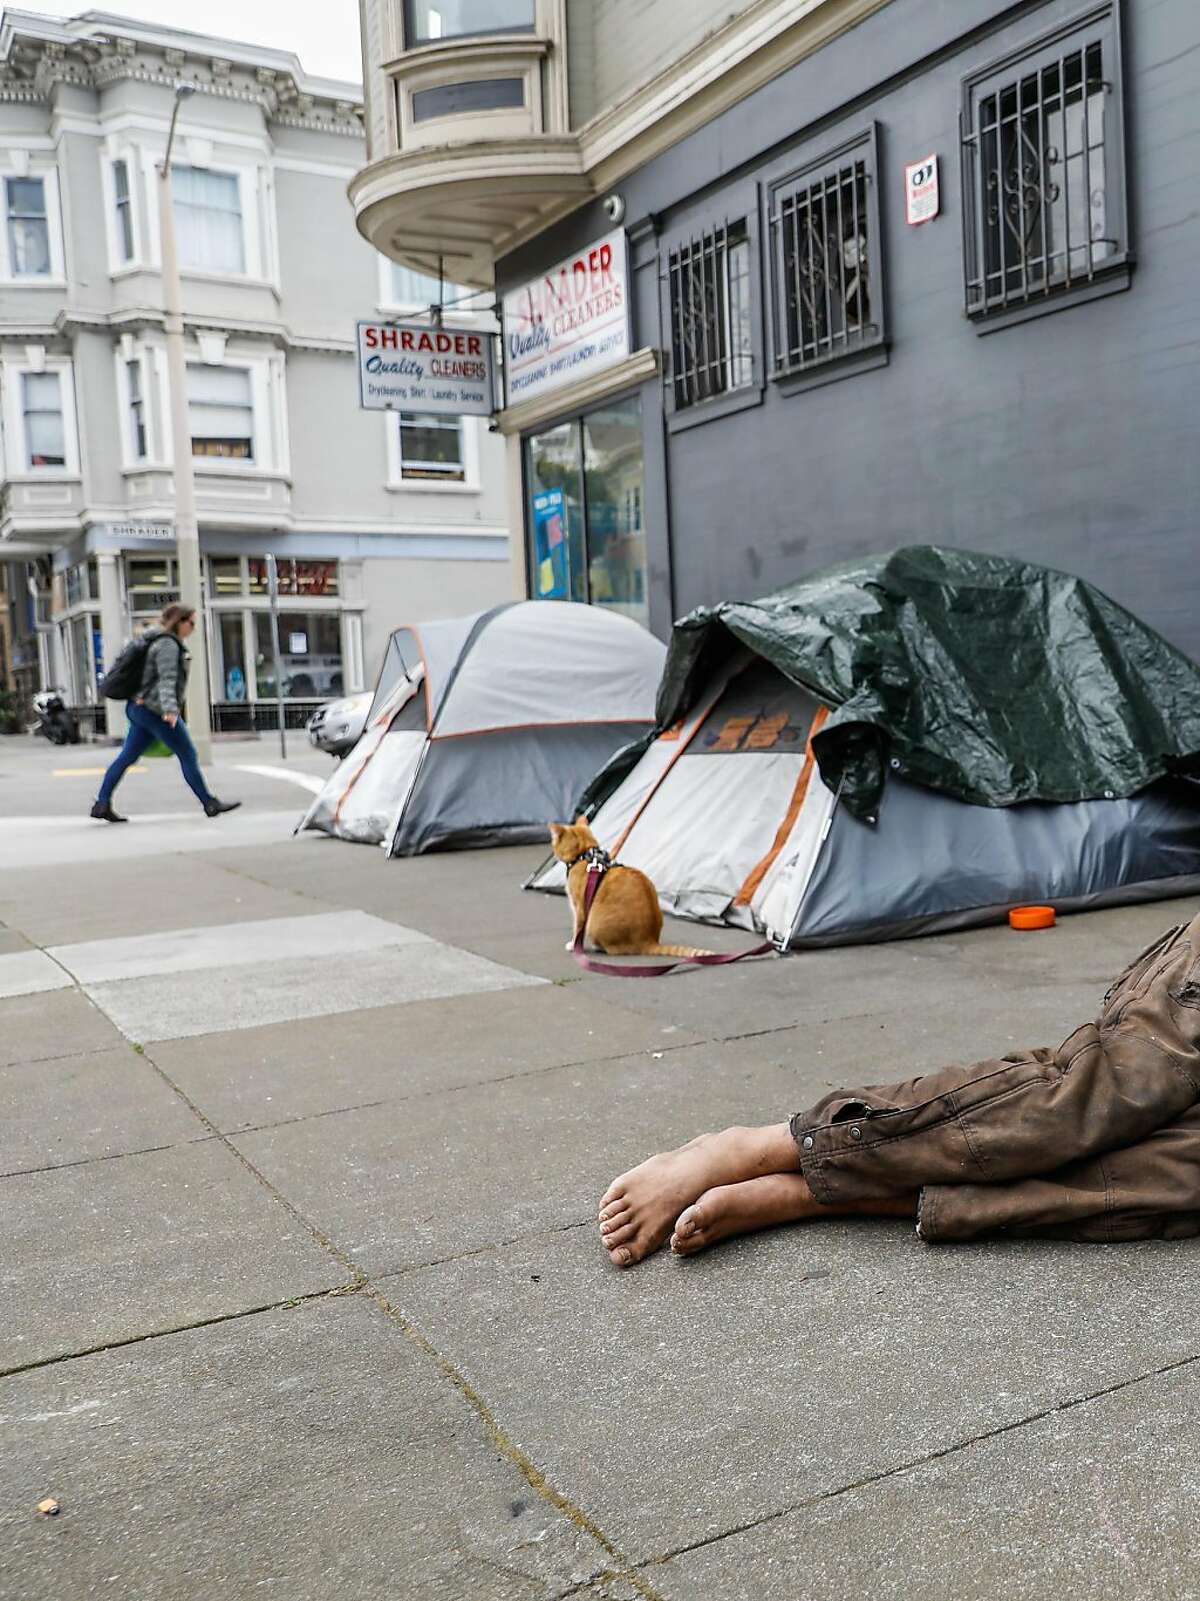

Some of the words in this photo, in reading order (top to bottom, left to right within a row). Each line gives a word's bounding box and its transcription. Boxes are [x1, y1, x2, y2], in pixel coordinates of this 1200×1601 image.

[510, 326, 551, 360] Quality
[553, 283, 623, 337] CLEANERS
[366, 328, 481, 356] SHRADER
[366, 355, 424, 381] Quality
[431, 358, 487, 380] CLEANERS
